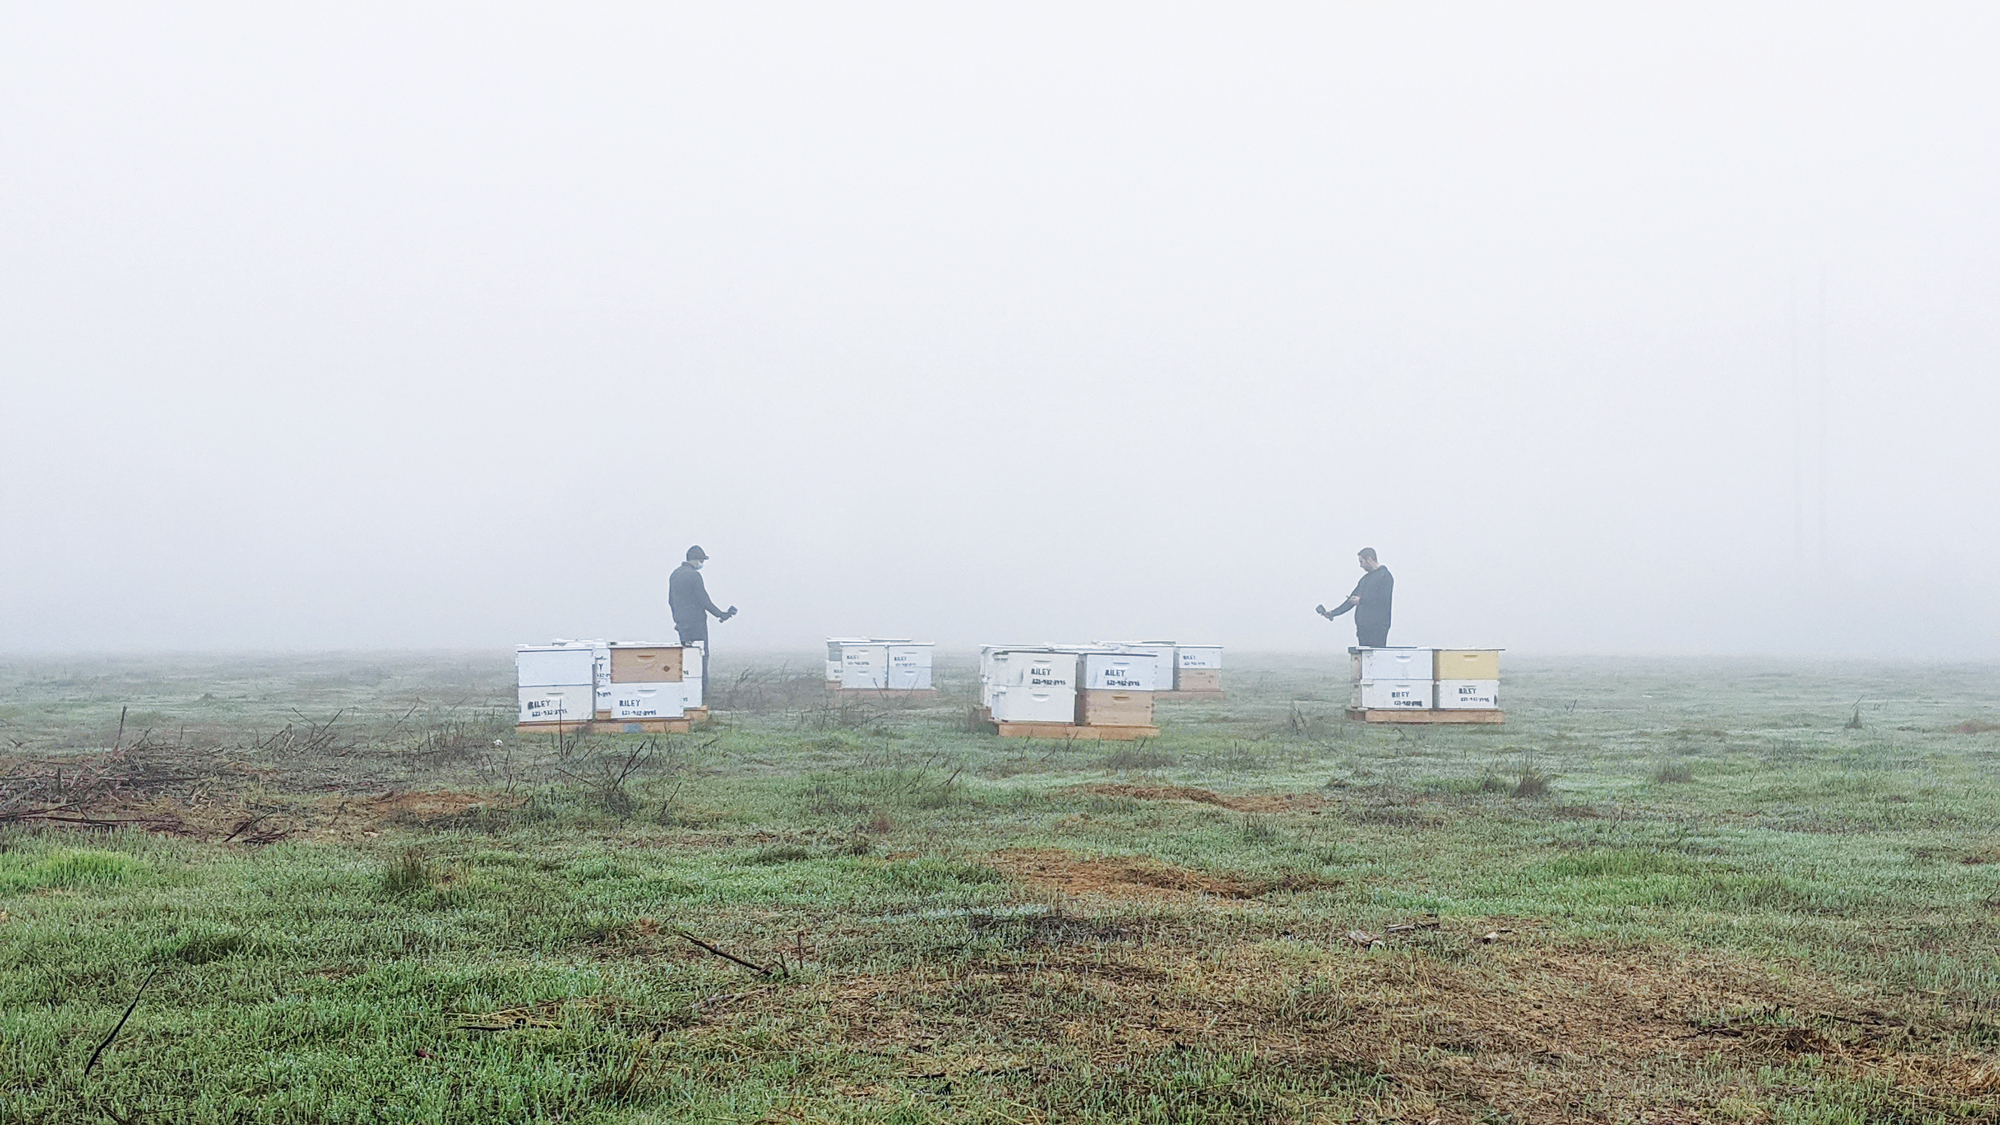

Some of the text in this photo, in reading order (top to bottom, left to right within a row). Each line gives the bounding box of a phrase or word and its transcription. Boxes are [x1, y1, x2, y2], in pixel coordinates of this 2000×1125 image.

[1030, 668, 1052, 676] RILEY
[1105, 669, 1126, 677] RILEY
[527, 699, 551, 710] RILEY
[619, 699, 641, 707] RILEY
